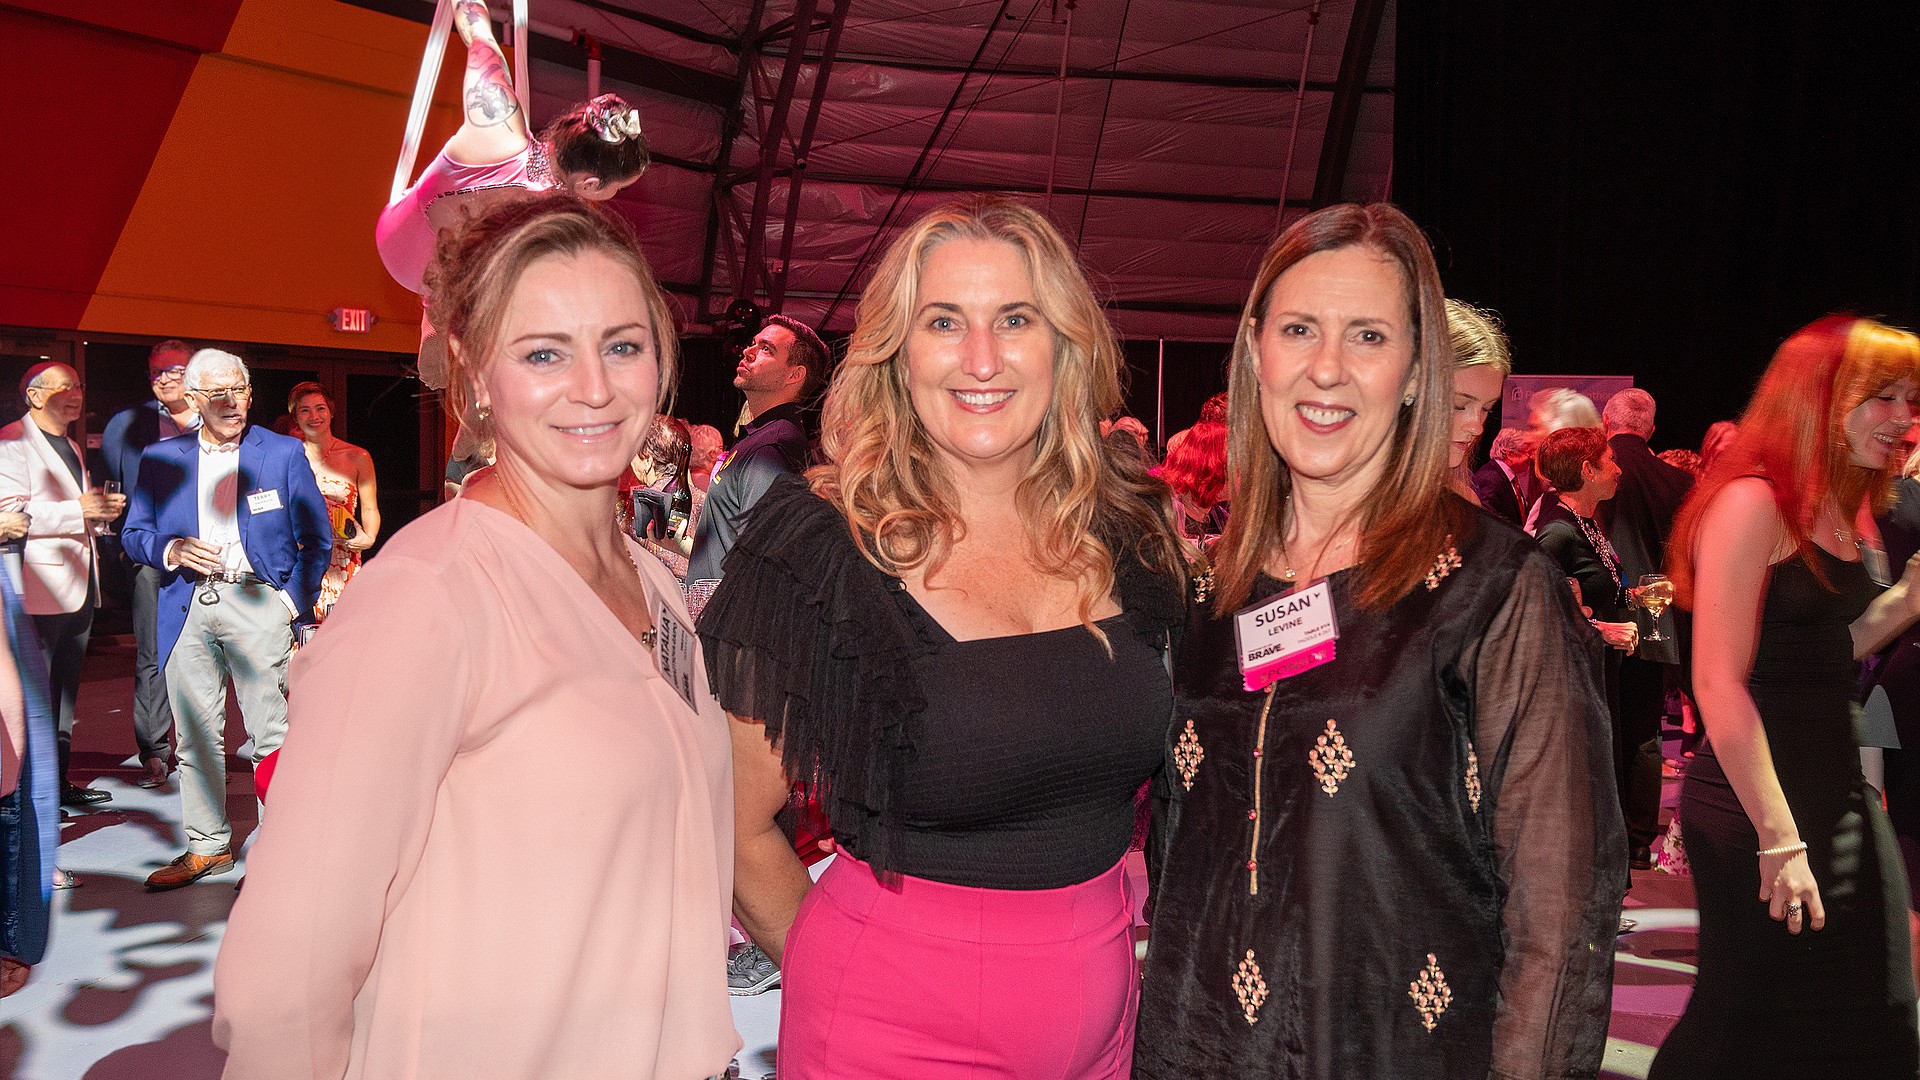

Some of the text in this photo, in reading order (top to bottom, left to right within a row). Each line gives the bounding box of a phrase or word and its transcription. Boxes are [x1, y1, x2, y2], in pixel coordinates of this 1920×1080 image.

[342, 308, 367, 331] EXIT
[1255, 595, 1311, 627] SUSAN
[1268, 617, 1303, 636] LEVINE
[660, 616, 672, 678] NATALIA
